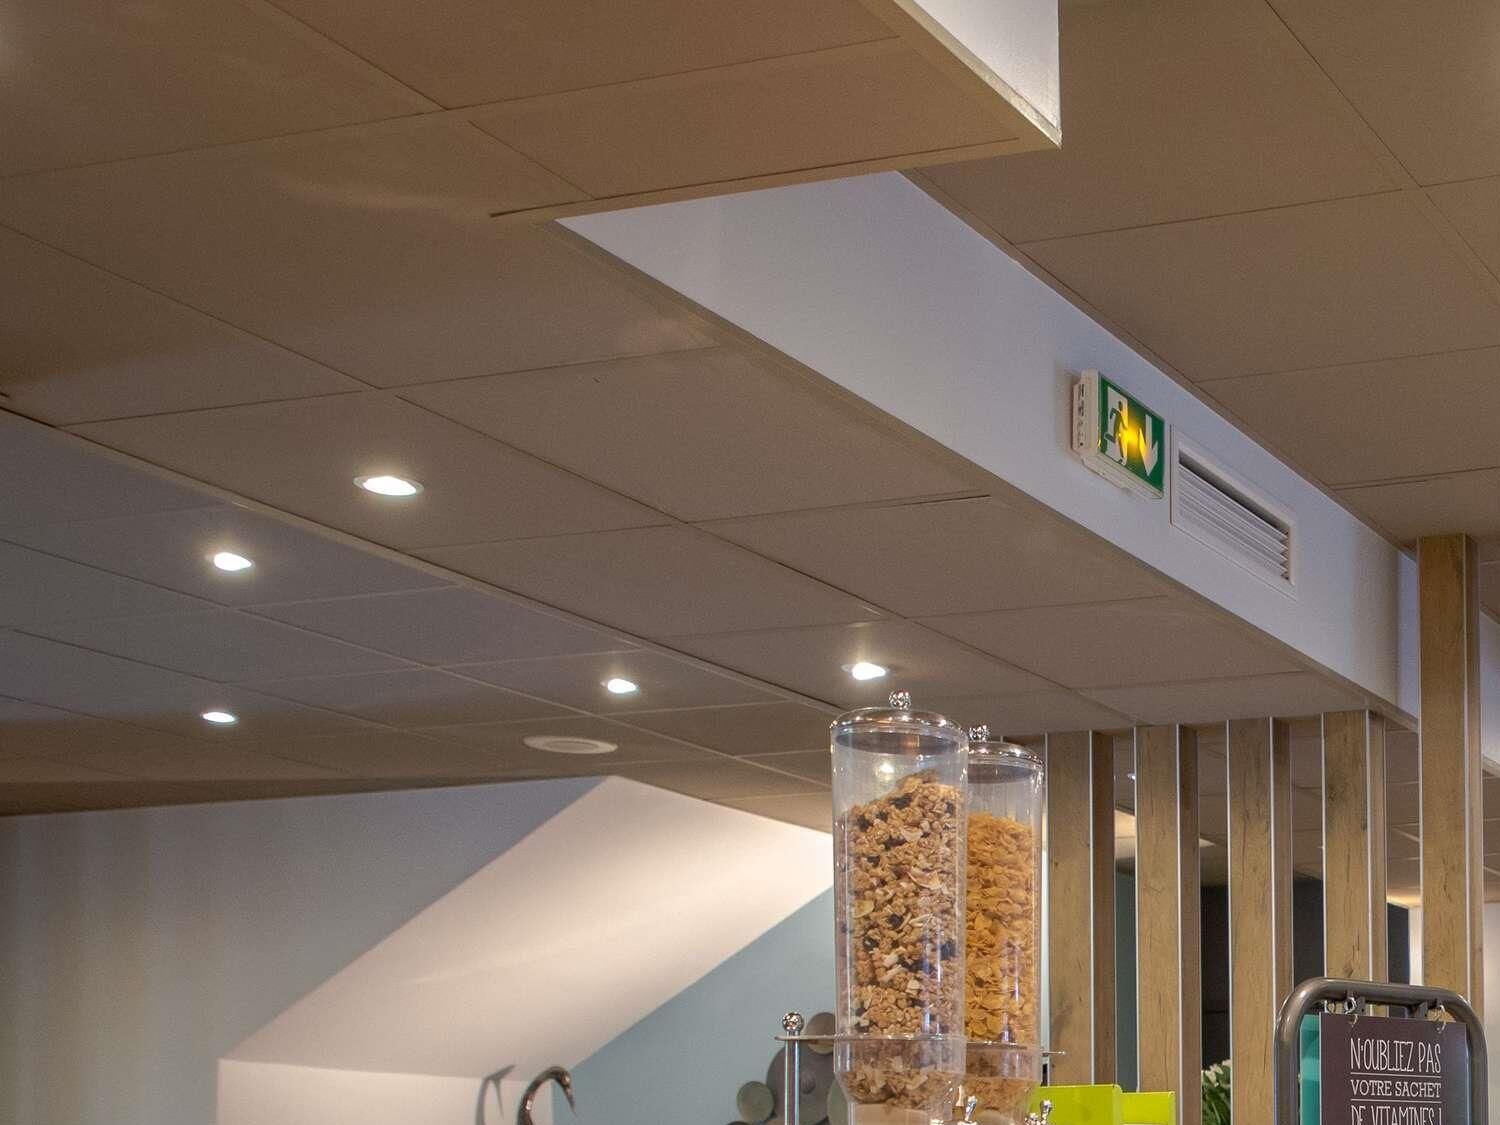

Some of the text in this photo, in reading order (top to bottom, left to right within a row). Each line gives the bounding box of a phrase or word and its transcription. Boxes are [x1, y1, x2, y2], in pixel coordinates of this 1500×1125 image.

[1350, 1038, 1442, 1074] N'OUBLIEZ PAS
[1350, 1079, 1442, 1098] VOTRE SACHET
